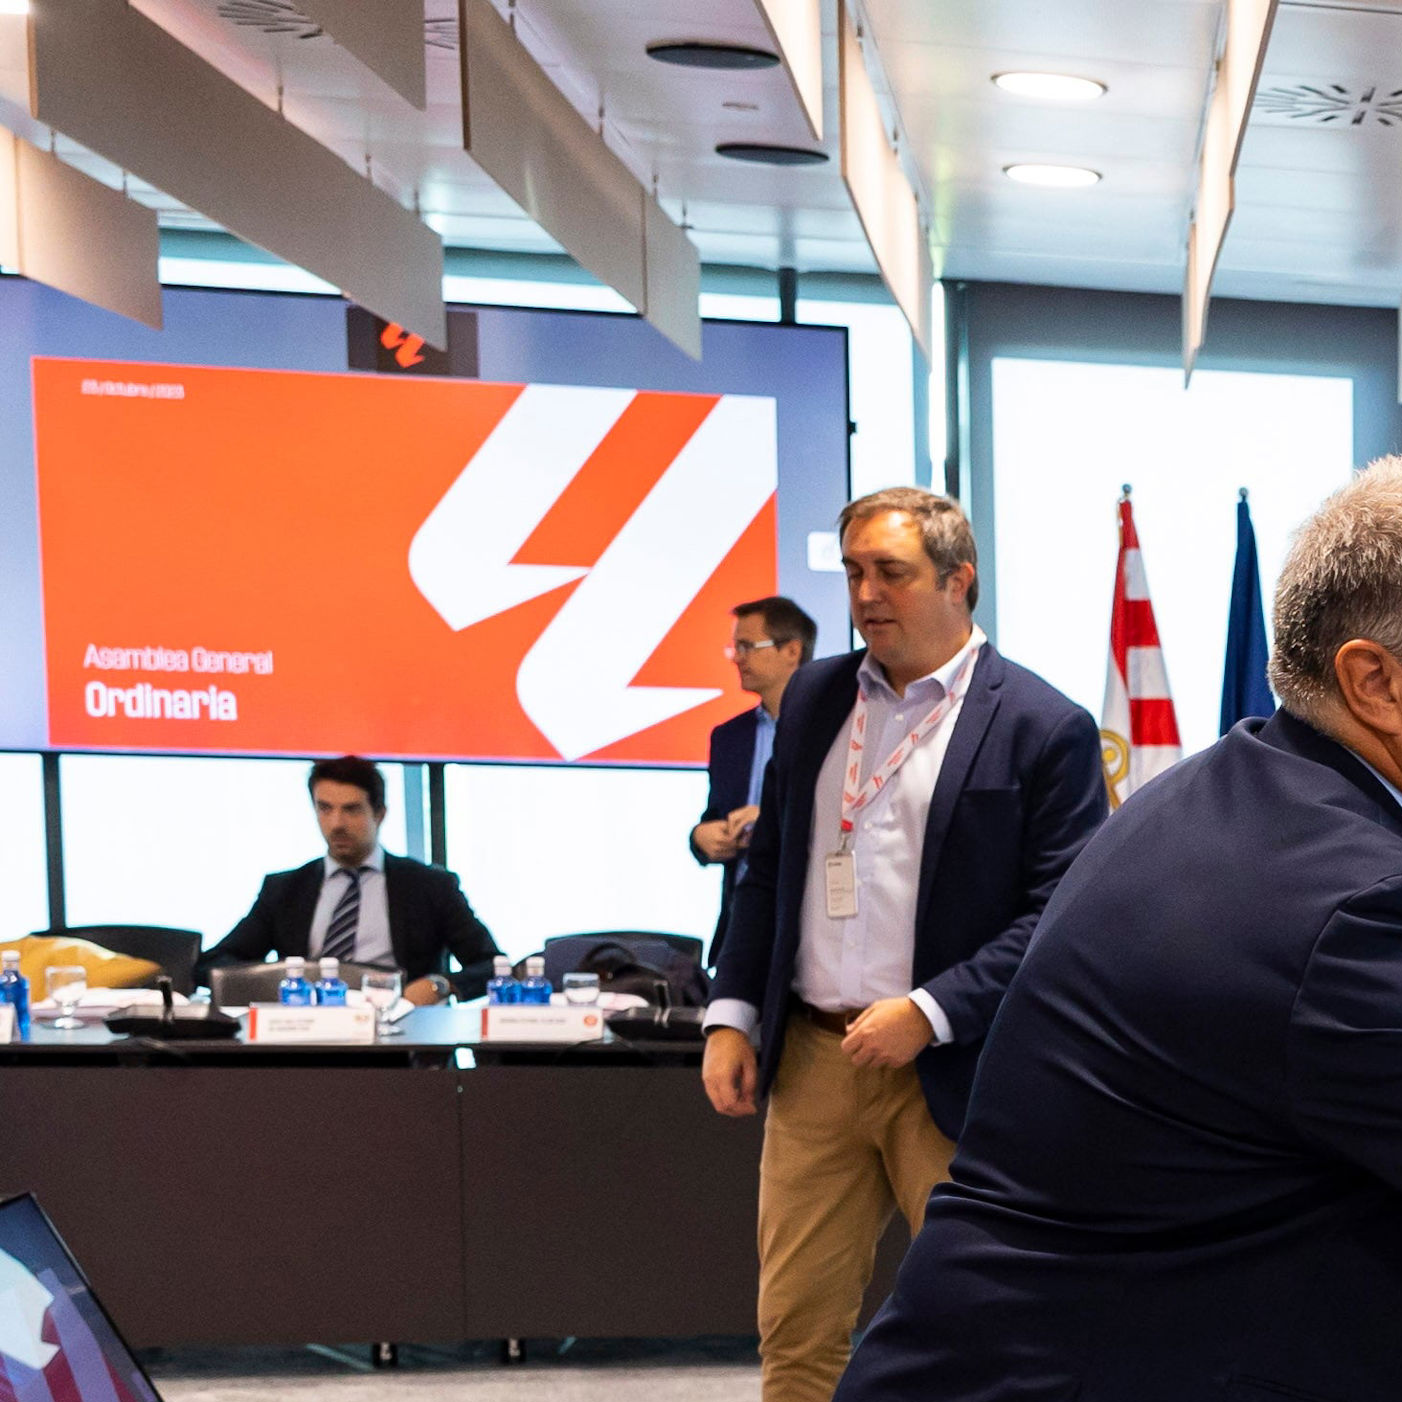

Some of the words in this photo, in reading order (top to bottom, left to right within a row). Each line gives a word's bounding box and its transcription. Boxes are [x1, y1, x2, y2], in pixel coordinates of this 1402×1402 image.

[83, 643, 189, 671] Asamblea
[191, 646, 274, 675] General
[85, 680, 238, 721] Ordinaria
